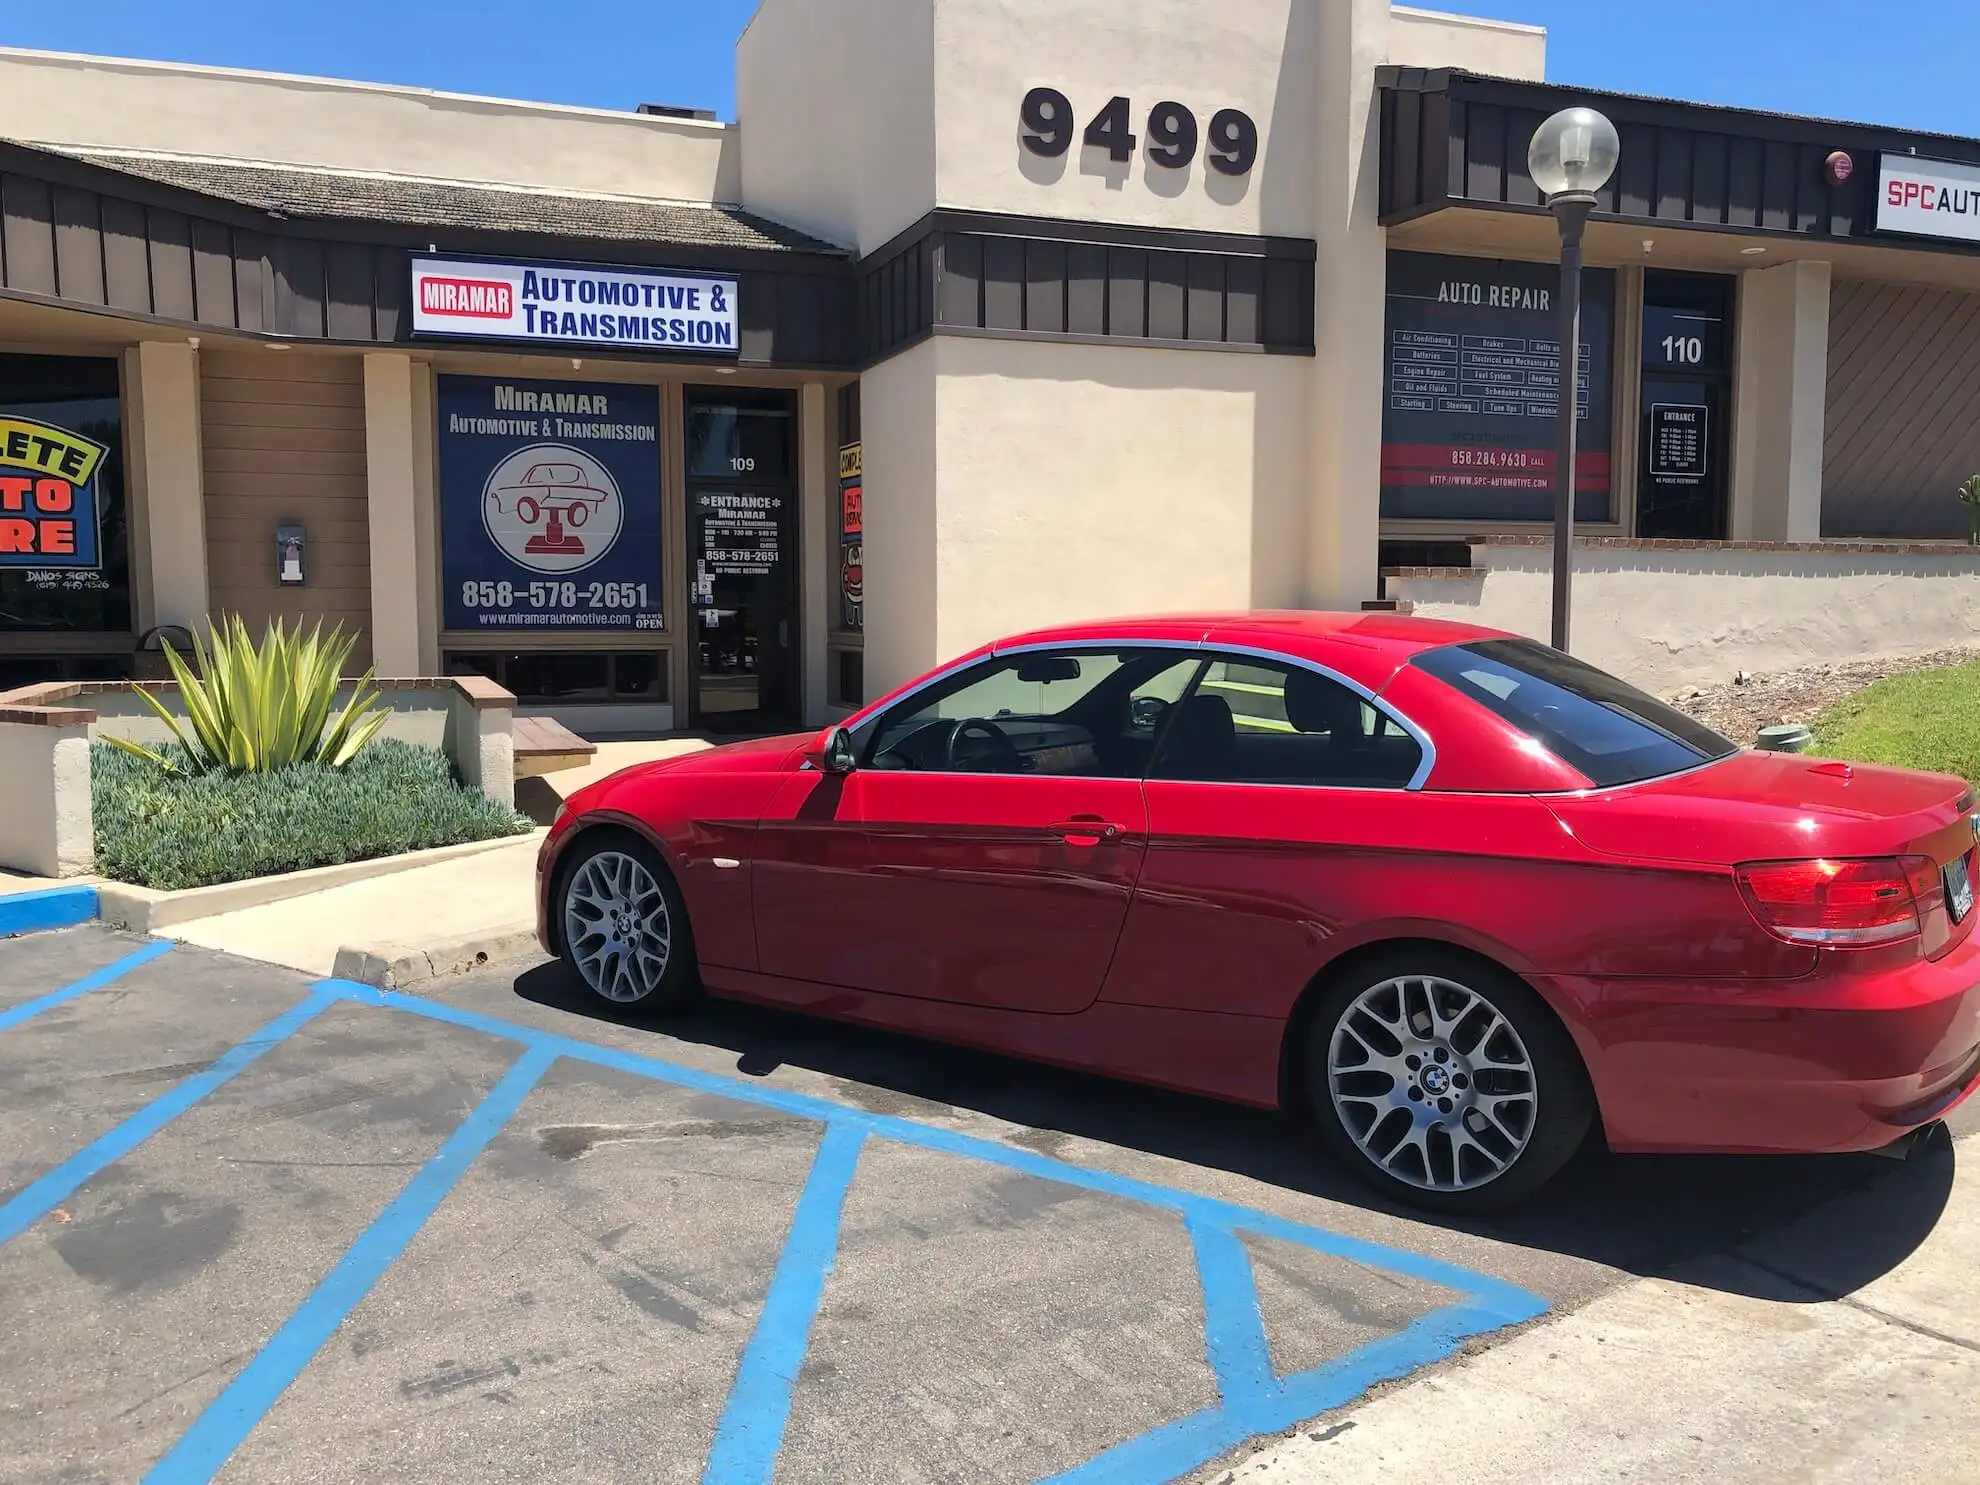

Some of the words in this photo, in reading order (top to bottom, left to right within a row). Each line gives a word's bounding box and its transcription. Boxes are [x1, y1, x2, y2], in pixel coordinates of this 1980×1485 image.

[1022, 87, 1257, 176] 9499
[423, 283, 510, 314] MIRAMAR
[522, 271, 700, 312] AUTOMOTIVE
[710, 284, 728, 313] &
[1438, 281, 1481, 305] AUTO
[1489, 285, 1549, 311] REPAIR
[522, 303, 732, 345] TRANSMISSION
[1402, 333, 1412, 341] Air
[1413, 334, 1451, 346] Conditioning
[1483, 340, 1504, 348] Brakes
[1412, 350, 1440, 360] Batteries
[1662, 336, 1702, 363] 110
[1472, 354, 1501, 364] Electrical
[1515, 358, 1548, 367] Mechanical
[1403, 366, 1424, 377] Engine
[1426, 367, 1446, 377] Repair
[1475, 370, 1488, 379] Fuel
[1489, 372, 1511, 382] System
[1405, 382, 1414, 391] Oil
[1416, 383, 1427, 391] and
[1429, 384, 1447, 392] Fluids
[1485, 387, 1519, 397] Scheduled
[494, 385, 608, 415] MIRAMAR
[1400, 399, 1425, 409] Starting
[1446, 401, 1472, 412] Steering
[1490, 403, 1504, 412] Tune
[1506, 404, 1517, 413] Ups
[1664, 412, 1695, 422] ENTRANCE
[450, 413, 538, 436] AUTOMOTIVE
[542, 419, 552, 437] &
[555, 418, 655, 441] TRANSMISSION
[0, 431, 88, 478] ETE
[1452, 450, 1526, 467] 858.284.9630
[1530, 458, 1544, 466] CALL
[730, 458, 755, 471] 109
[718, 508, 766, 519] MIRAMAR
[706, 551, 779, 561] 858-578-2651
[26, 571, 62, 582] DANOS
[65, 571, 100, 581] SIGNS
[462, 581, 648, 608] 858-578-2651
[479, 612, 631, 626] www.miramarautomotive.com
[635, 619, 663, 629] OPEN
